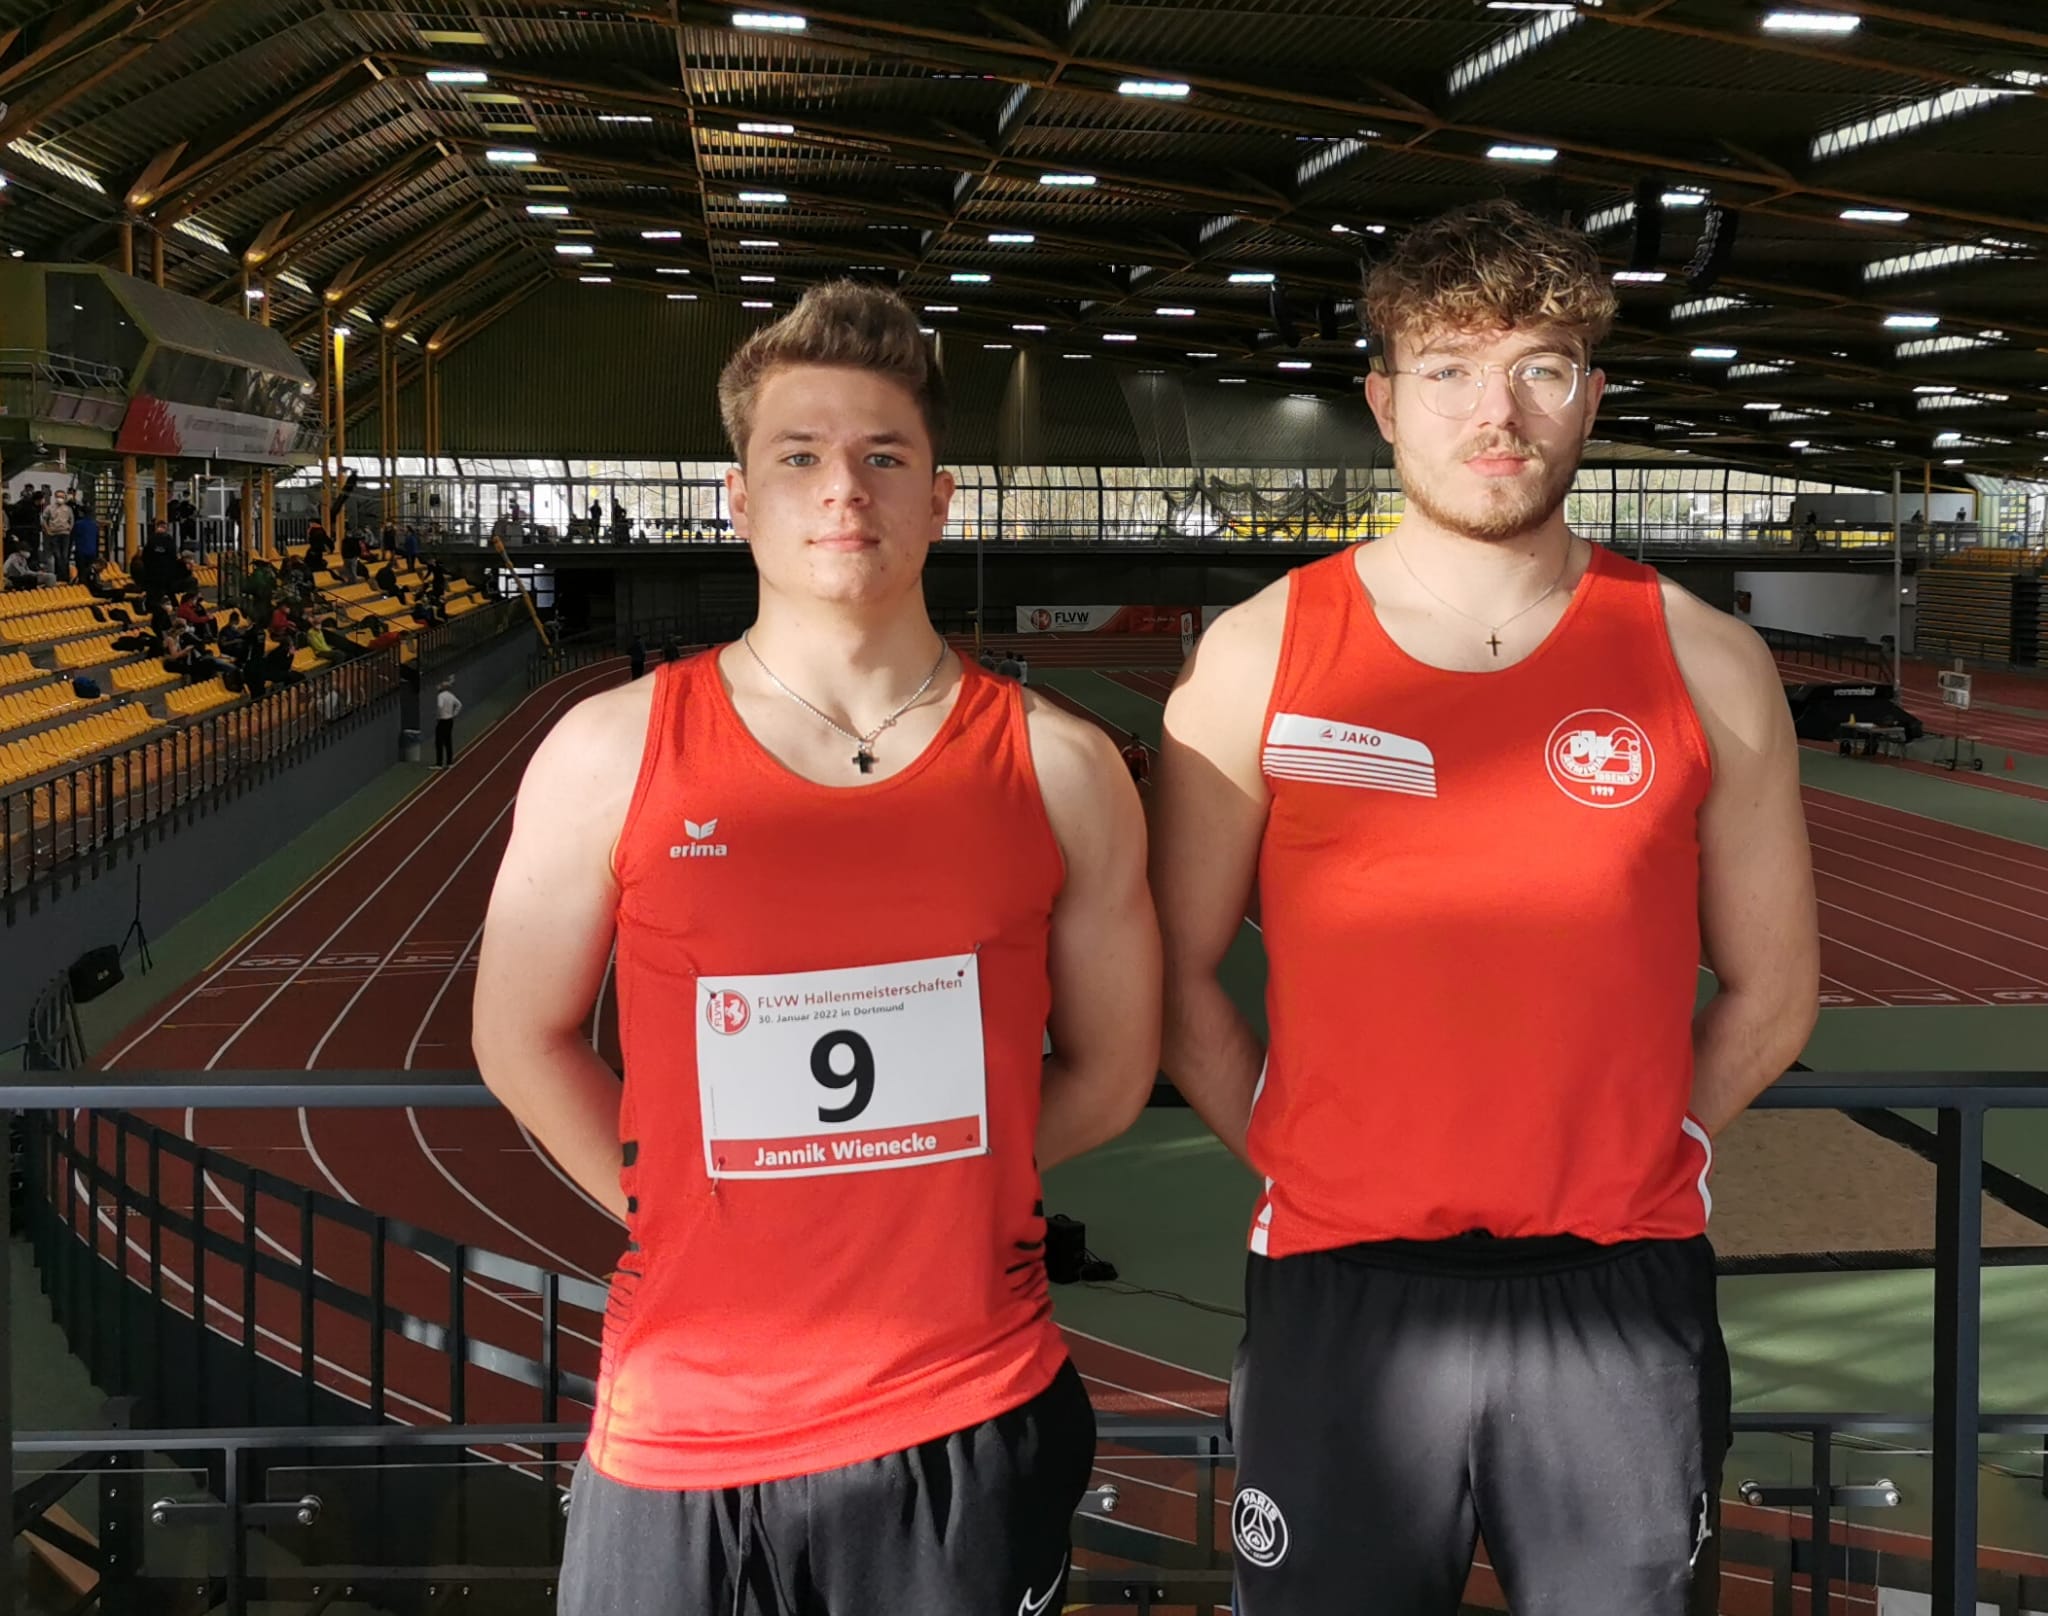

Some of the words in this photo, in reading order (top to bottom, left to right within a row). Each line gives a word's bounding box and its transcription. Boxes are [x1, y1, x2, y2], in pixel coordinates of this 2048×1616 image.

[1055, 611, 1089, 623] FLVW
[1340, 730, 1382, 747] JAKO
[1590, 785, 1615, 797] 1929
[670, 842, 727, 858] erima
[758, 994, 799, 1009] FLVW
[805, 978, 963, 1006] Hallenmeisterschaften
[759, 1014, 774, 1024] 30.
[777, 1012, 810, 1022] Januar
[814, 1009, 837, 1020] 2022
[841, 1008, 851, 1017] in
[854, 1002, 905, 1016] Dortmund
[810, 1029, 875, 1123] 9
[754, 1143, 826, 1167] Jannik
[831, 1132, 937, 1160] Wienecke
[1242, 1491, 1278, 1522] PARIS
